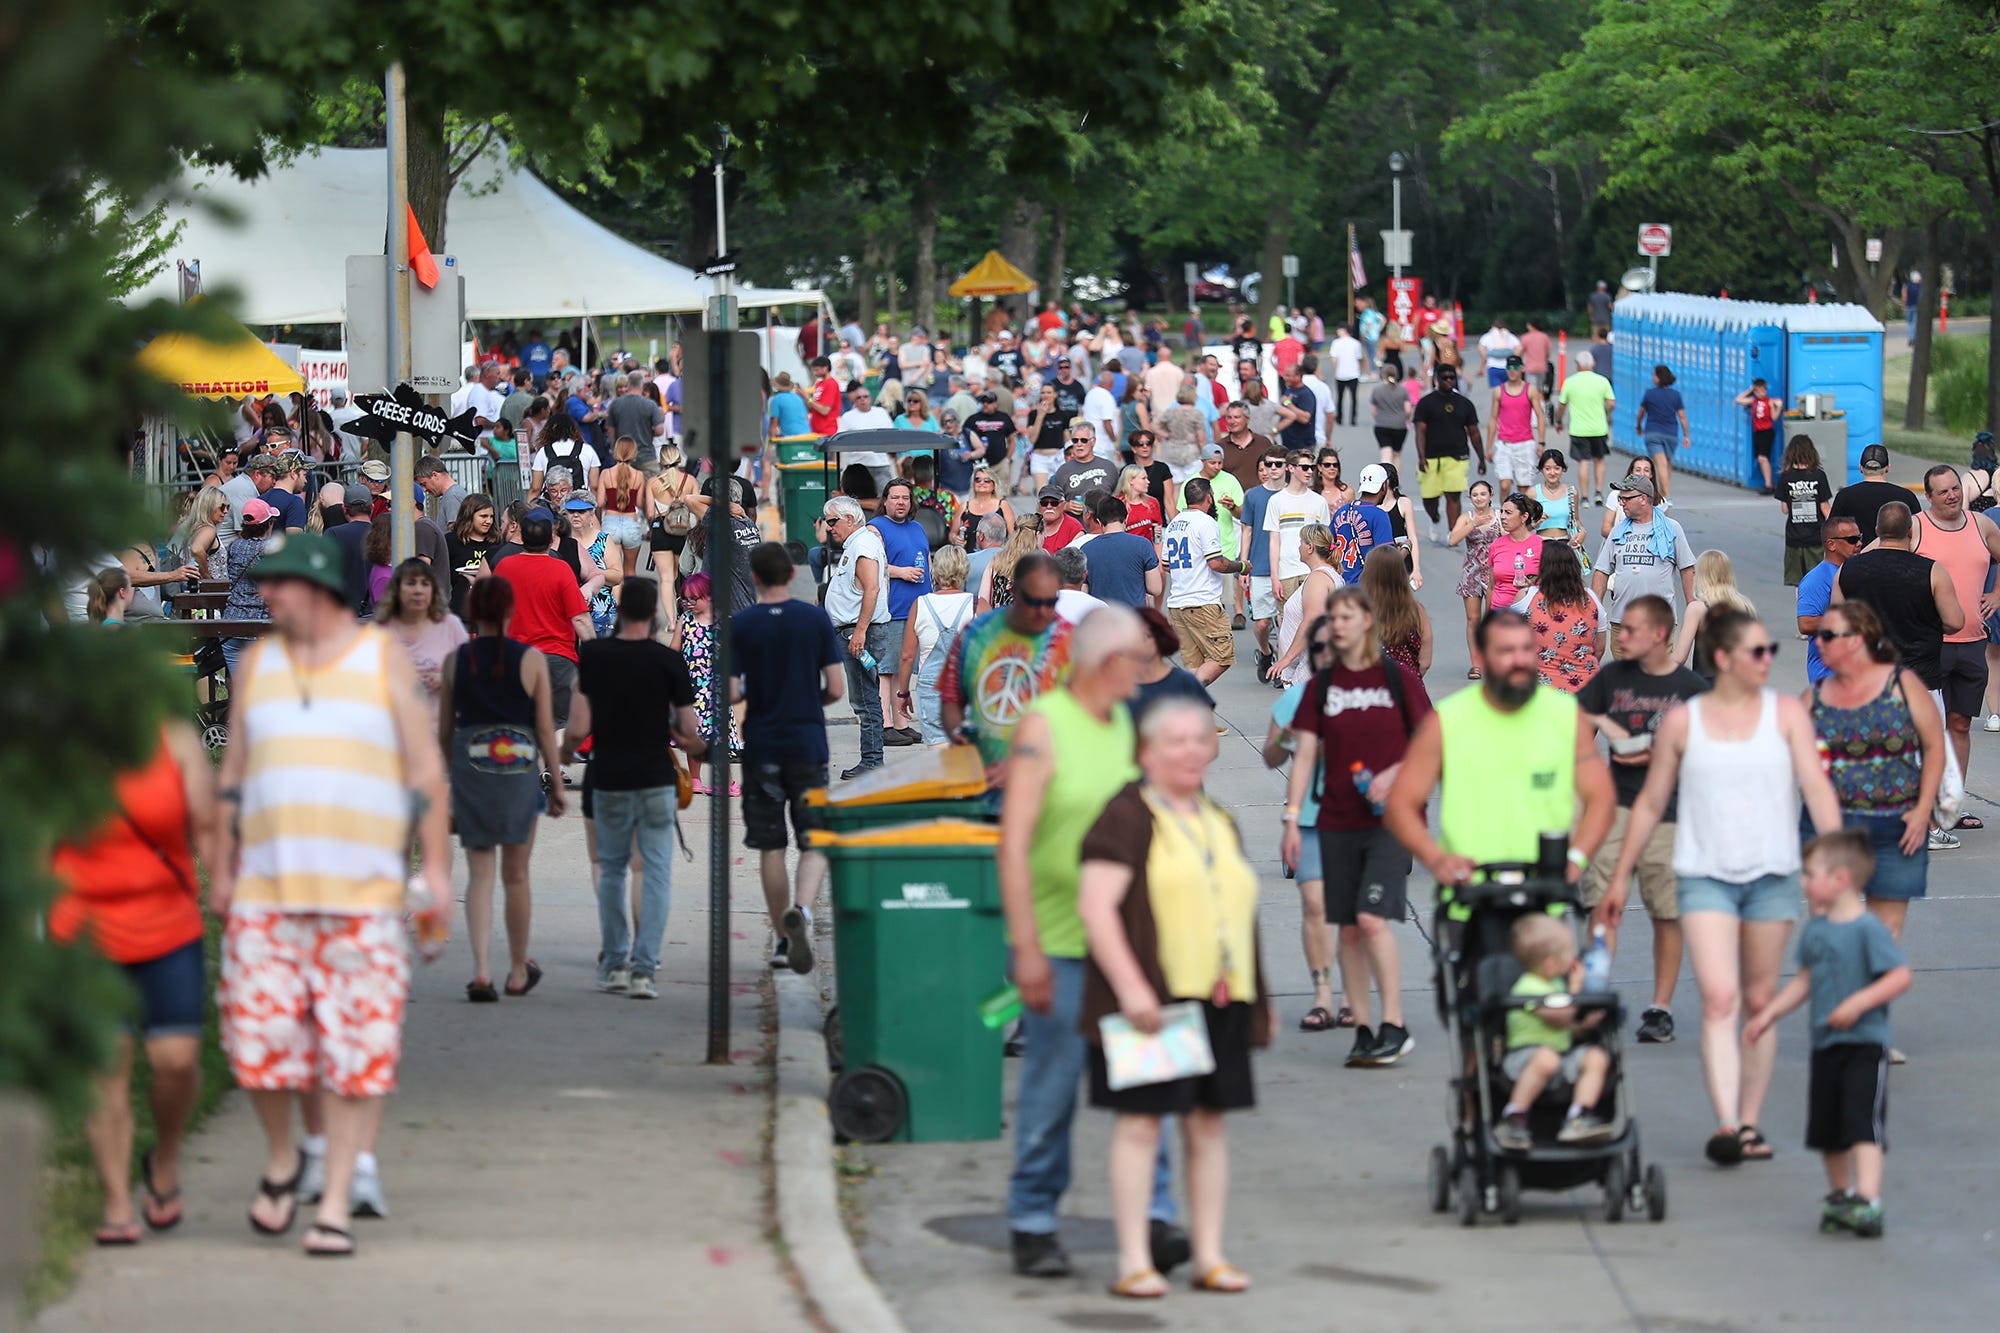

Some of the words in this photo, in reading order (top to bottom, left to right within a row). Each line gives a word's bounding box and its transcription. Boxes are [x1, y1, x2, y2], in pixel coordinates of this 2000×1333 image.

[372, 399, 413, 424] CHEESE
[412, 411, 447, 434] CURDS
[1166, 536, 1192, 569] 24
[1624, 555, 1641, 565] TEAM
[1640, 556, 1654, 566] USA
